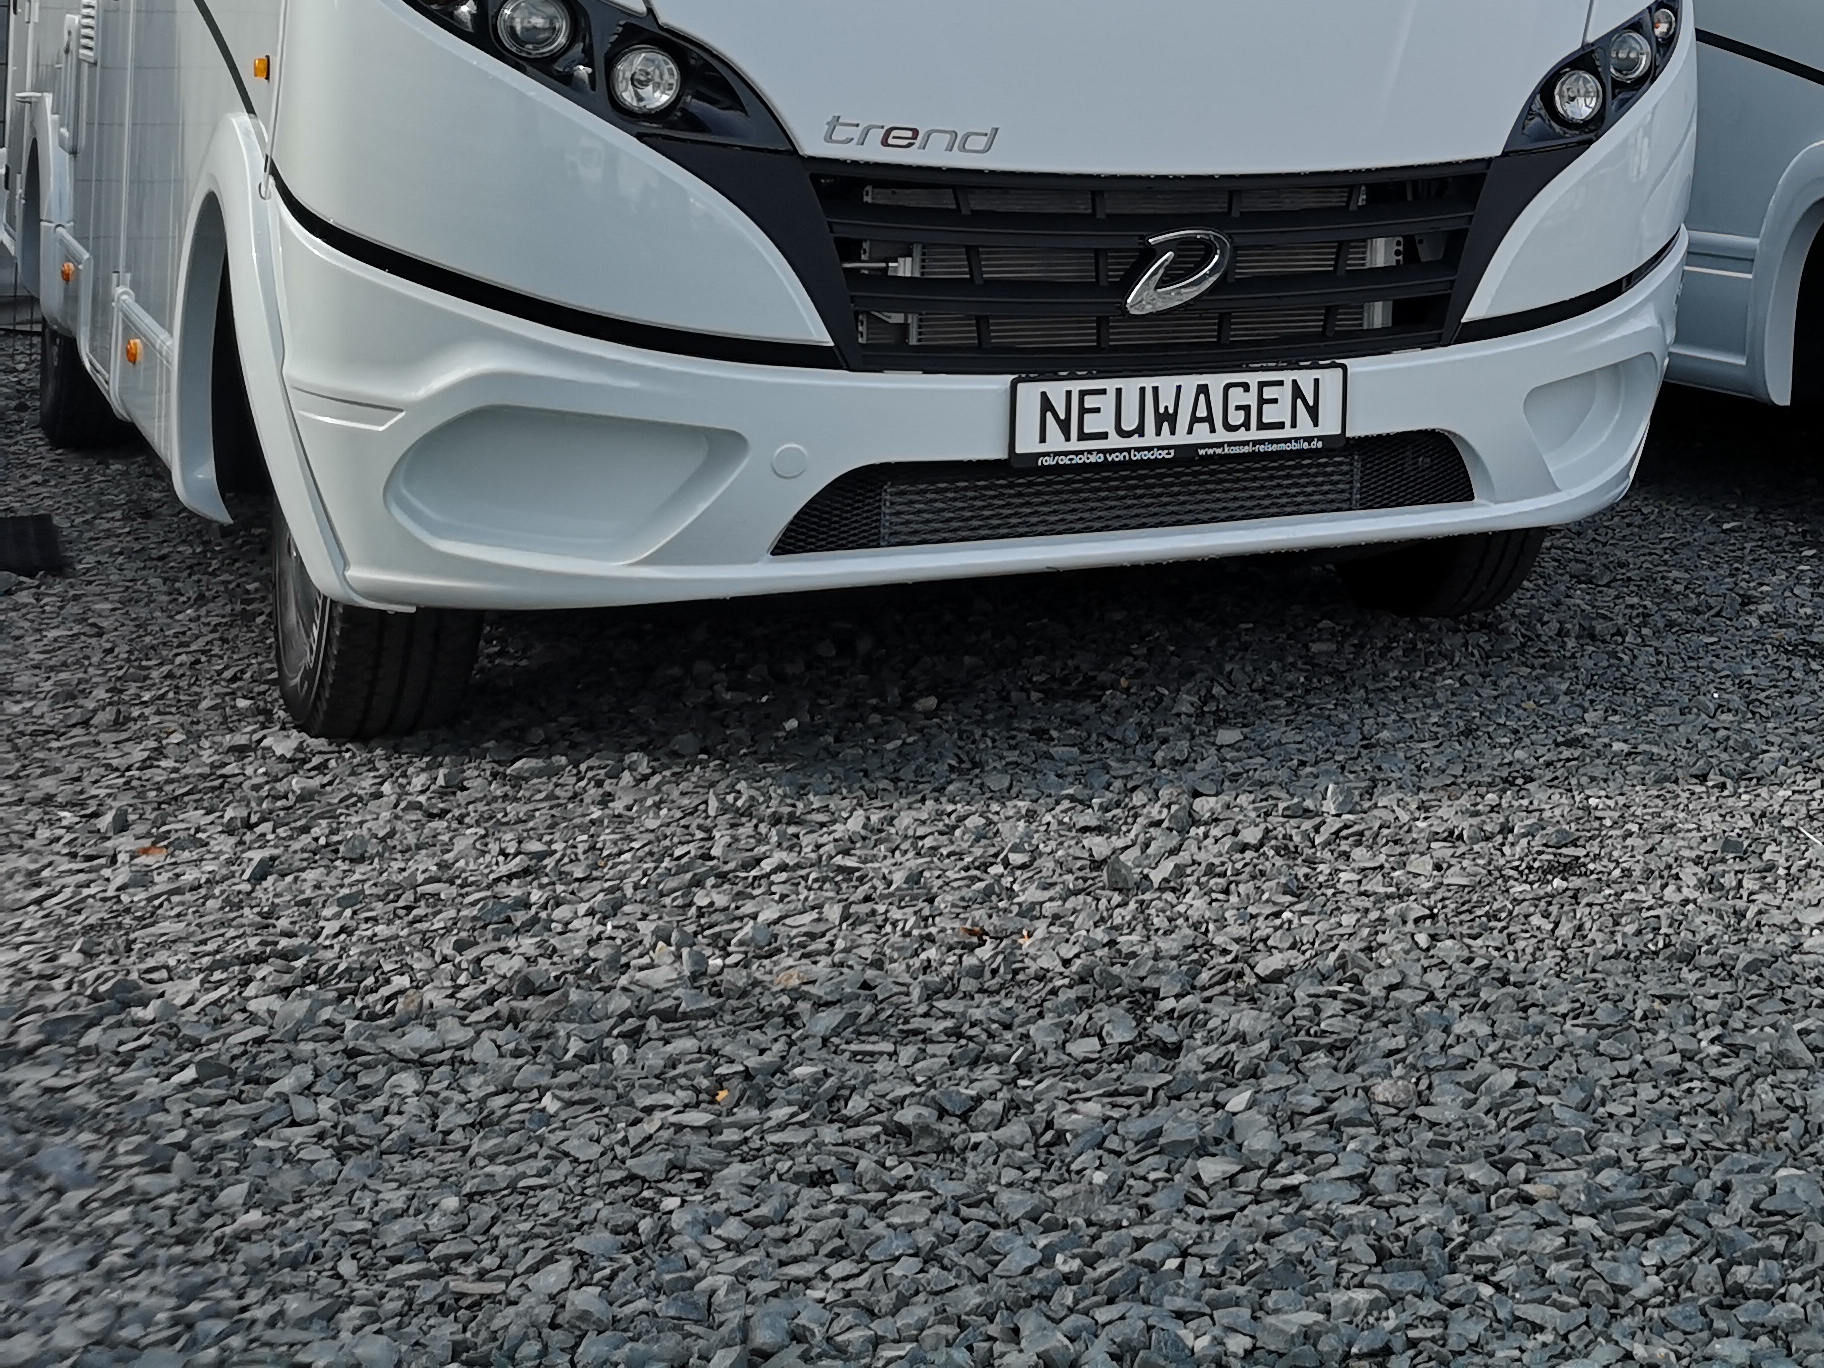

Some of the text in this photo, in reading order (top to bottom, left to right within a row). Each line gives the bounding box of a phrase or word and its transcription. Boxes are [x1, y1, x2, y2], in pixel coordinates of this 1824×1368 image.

[823, 114, 1000, 154] trend
[1038, 377, 1321, 444] NEUWAGEN
[1106, 451, 1129, 462] von
[1197, 437, 1323, 456] www.kassel-reisemobile.de
